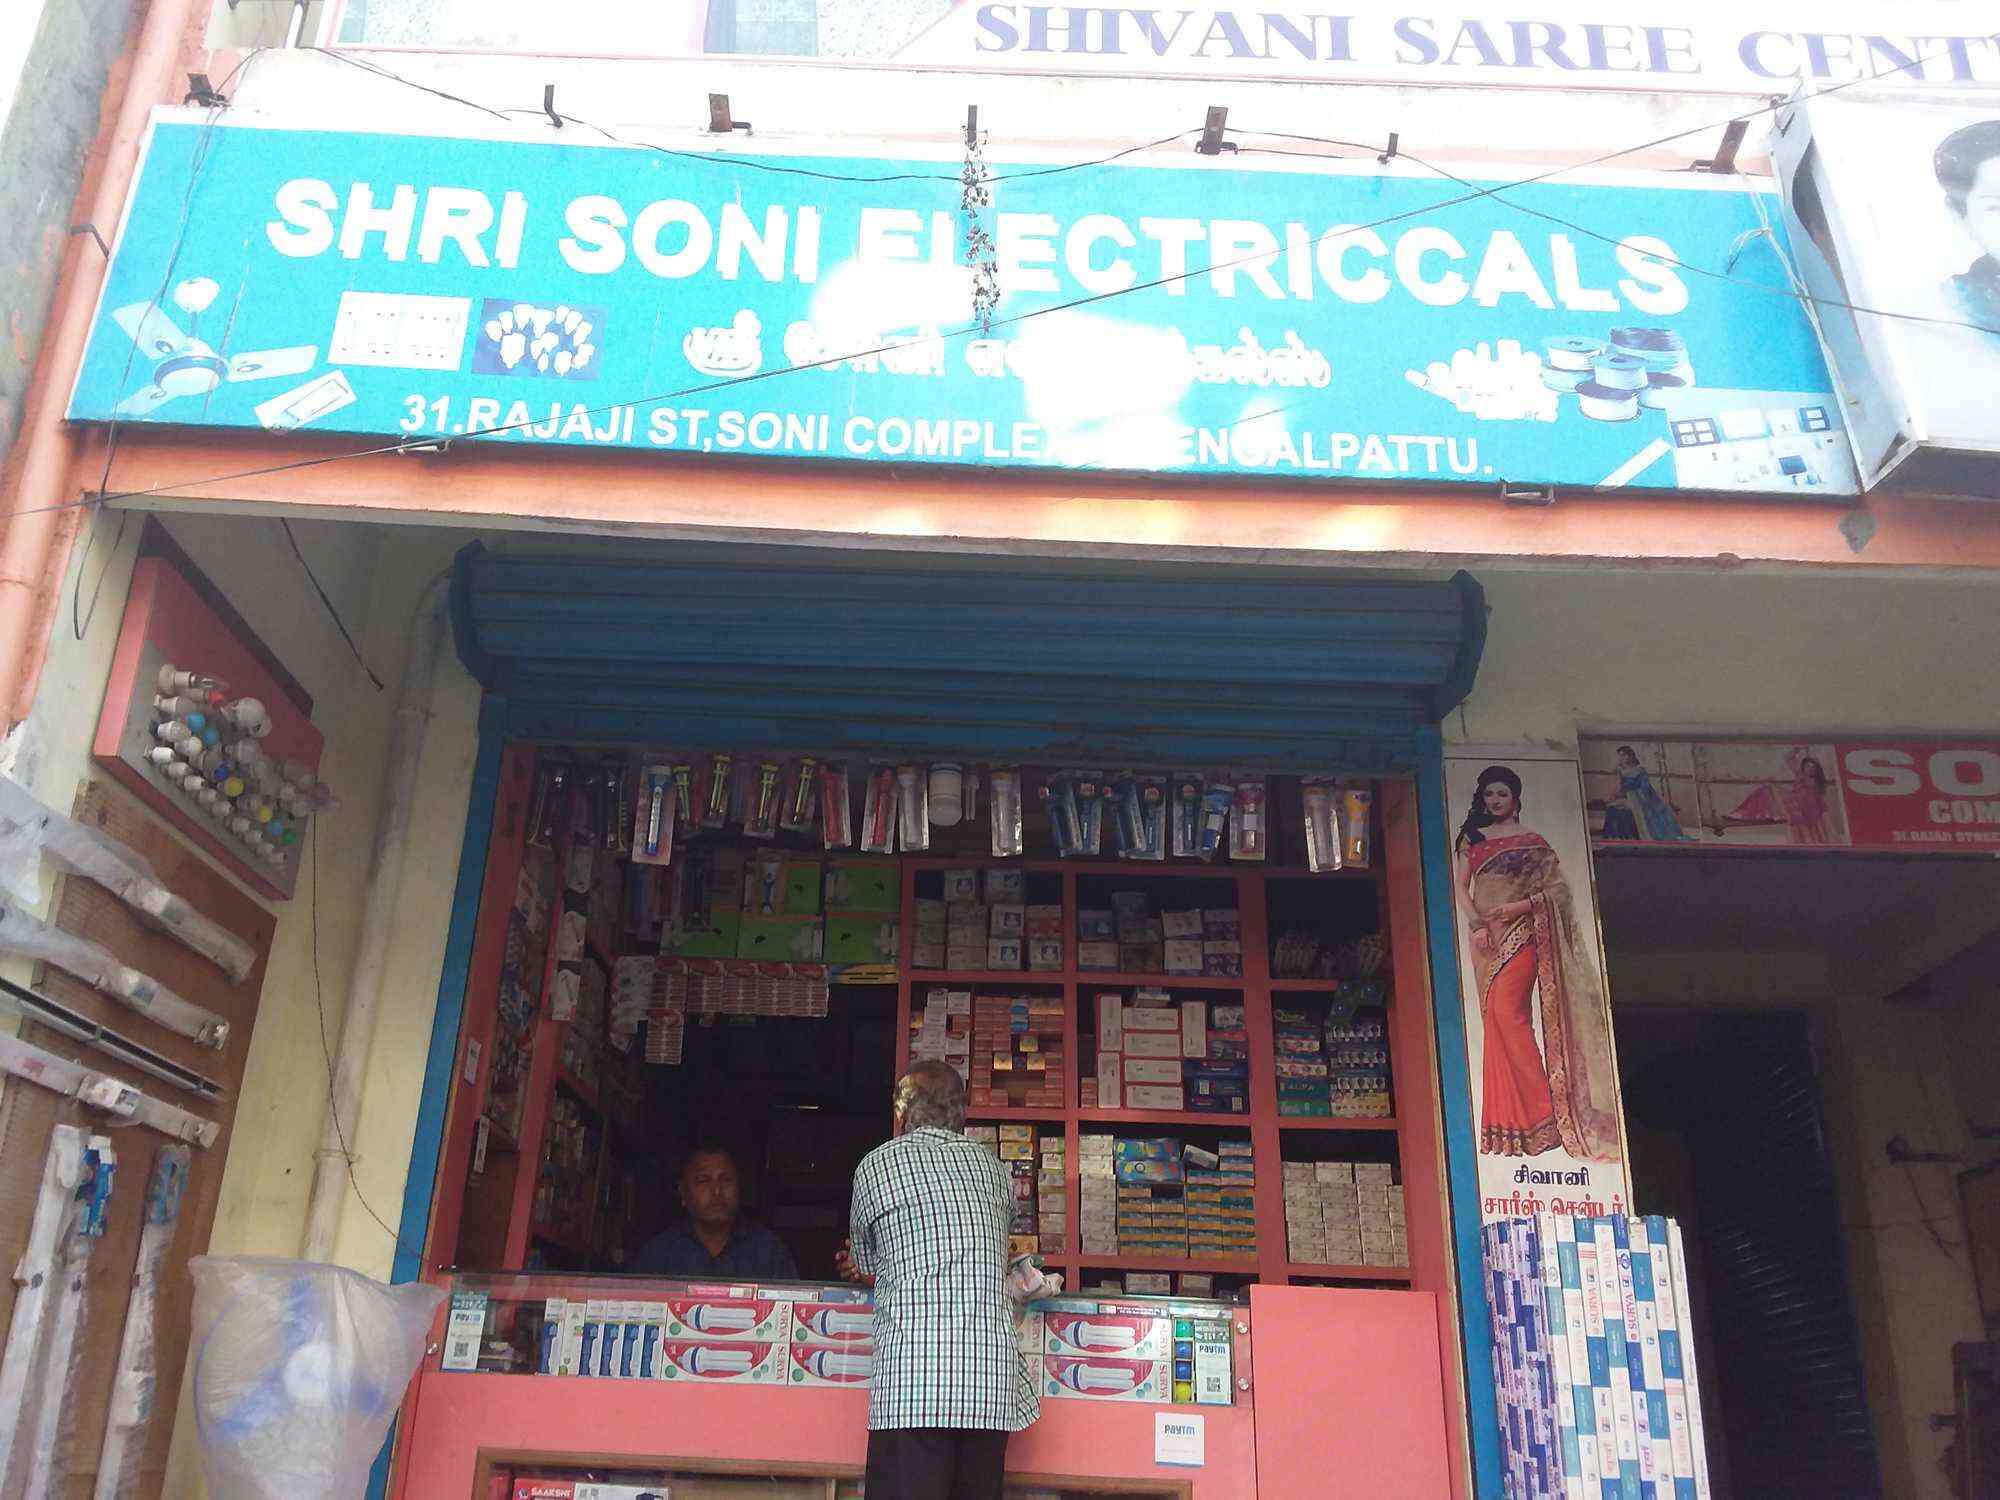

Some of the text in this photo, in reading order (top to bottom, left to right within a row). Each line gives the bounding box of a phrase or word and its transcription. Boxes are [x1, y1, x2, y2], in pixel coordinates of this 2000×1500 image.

[973, 4, 2000, 81] SHIVANI SAREE CENT
[266, 178, 1689, 316] SHRI SONI ELECTRICCALS
[400, 393, 635, 443] 31.RAJAJI
[1514, 1164, 1590, 1186] சிவானி
[779, 1303, 791, 1339] SURYA
[1624, 1292, 1638, 1330] SURYA
[775, 1344, 786, 1380] SURYA
[1159, 1363, 1168, 1401] SURYA
